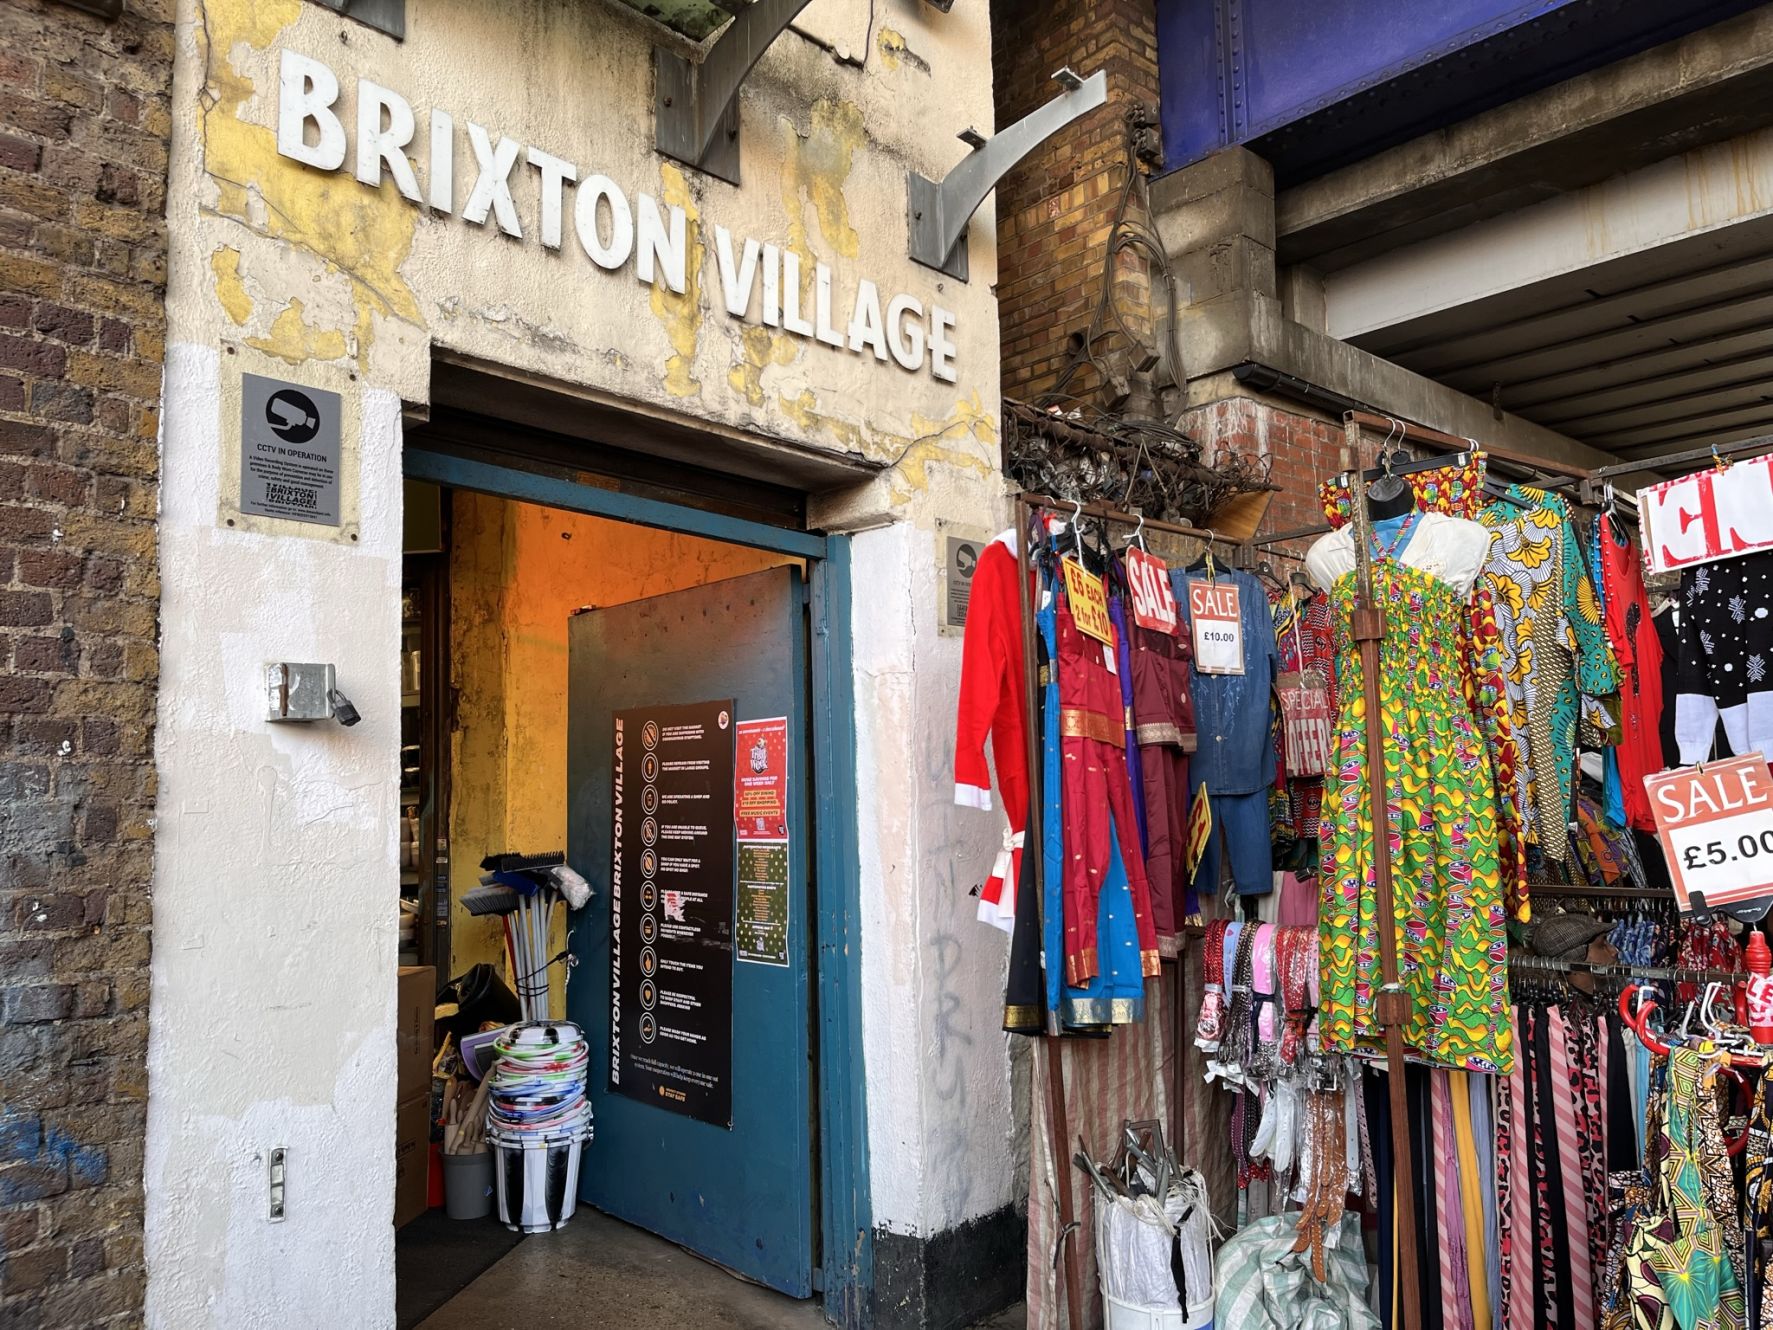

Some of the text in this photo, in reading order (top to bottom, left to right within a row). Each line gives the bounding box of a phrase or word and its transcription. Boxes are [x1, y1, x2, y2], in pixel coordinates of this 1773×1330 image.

[277, 48, 957, 383] BRIXTON VILLAGE
[257, 443, 327, 463] CCTV IN OPERATION
[271, 487, 314, 500] BRIXTON
[271, 493, 313, 506] VILLAGE
[1072, 566, 1105, 609] £6 EACH
[1128, 562, 1176, 625] SALE
[1192, 588, 1240, 618] SALE
[1075, 603, 1109, 638] 2 for £10
[1204, 631, 1234, 643] £10.00
[1281, 690, 1328, 711] SPECIAL
[1288, 718, 1332, 776] OFFER
[1657, 767, 1767, 823] SALE
[1683, 830, 1773, 869] £5.00
[612, 718, 624, 1085] BRIXTON VILLAGE BRIXTON VILLAGE
